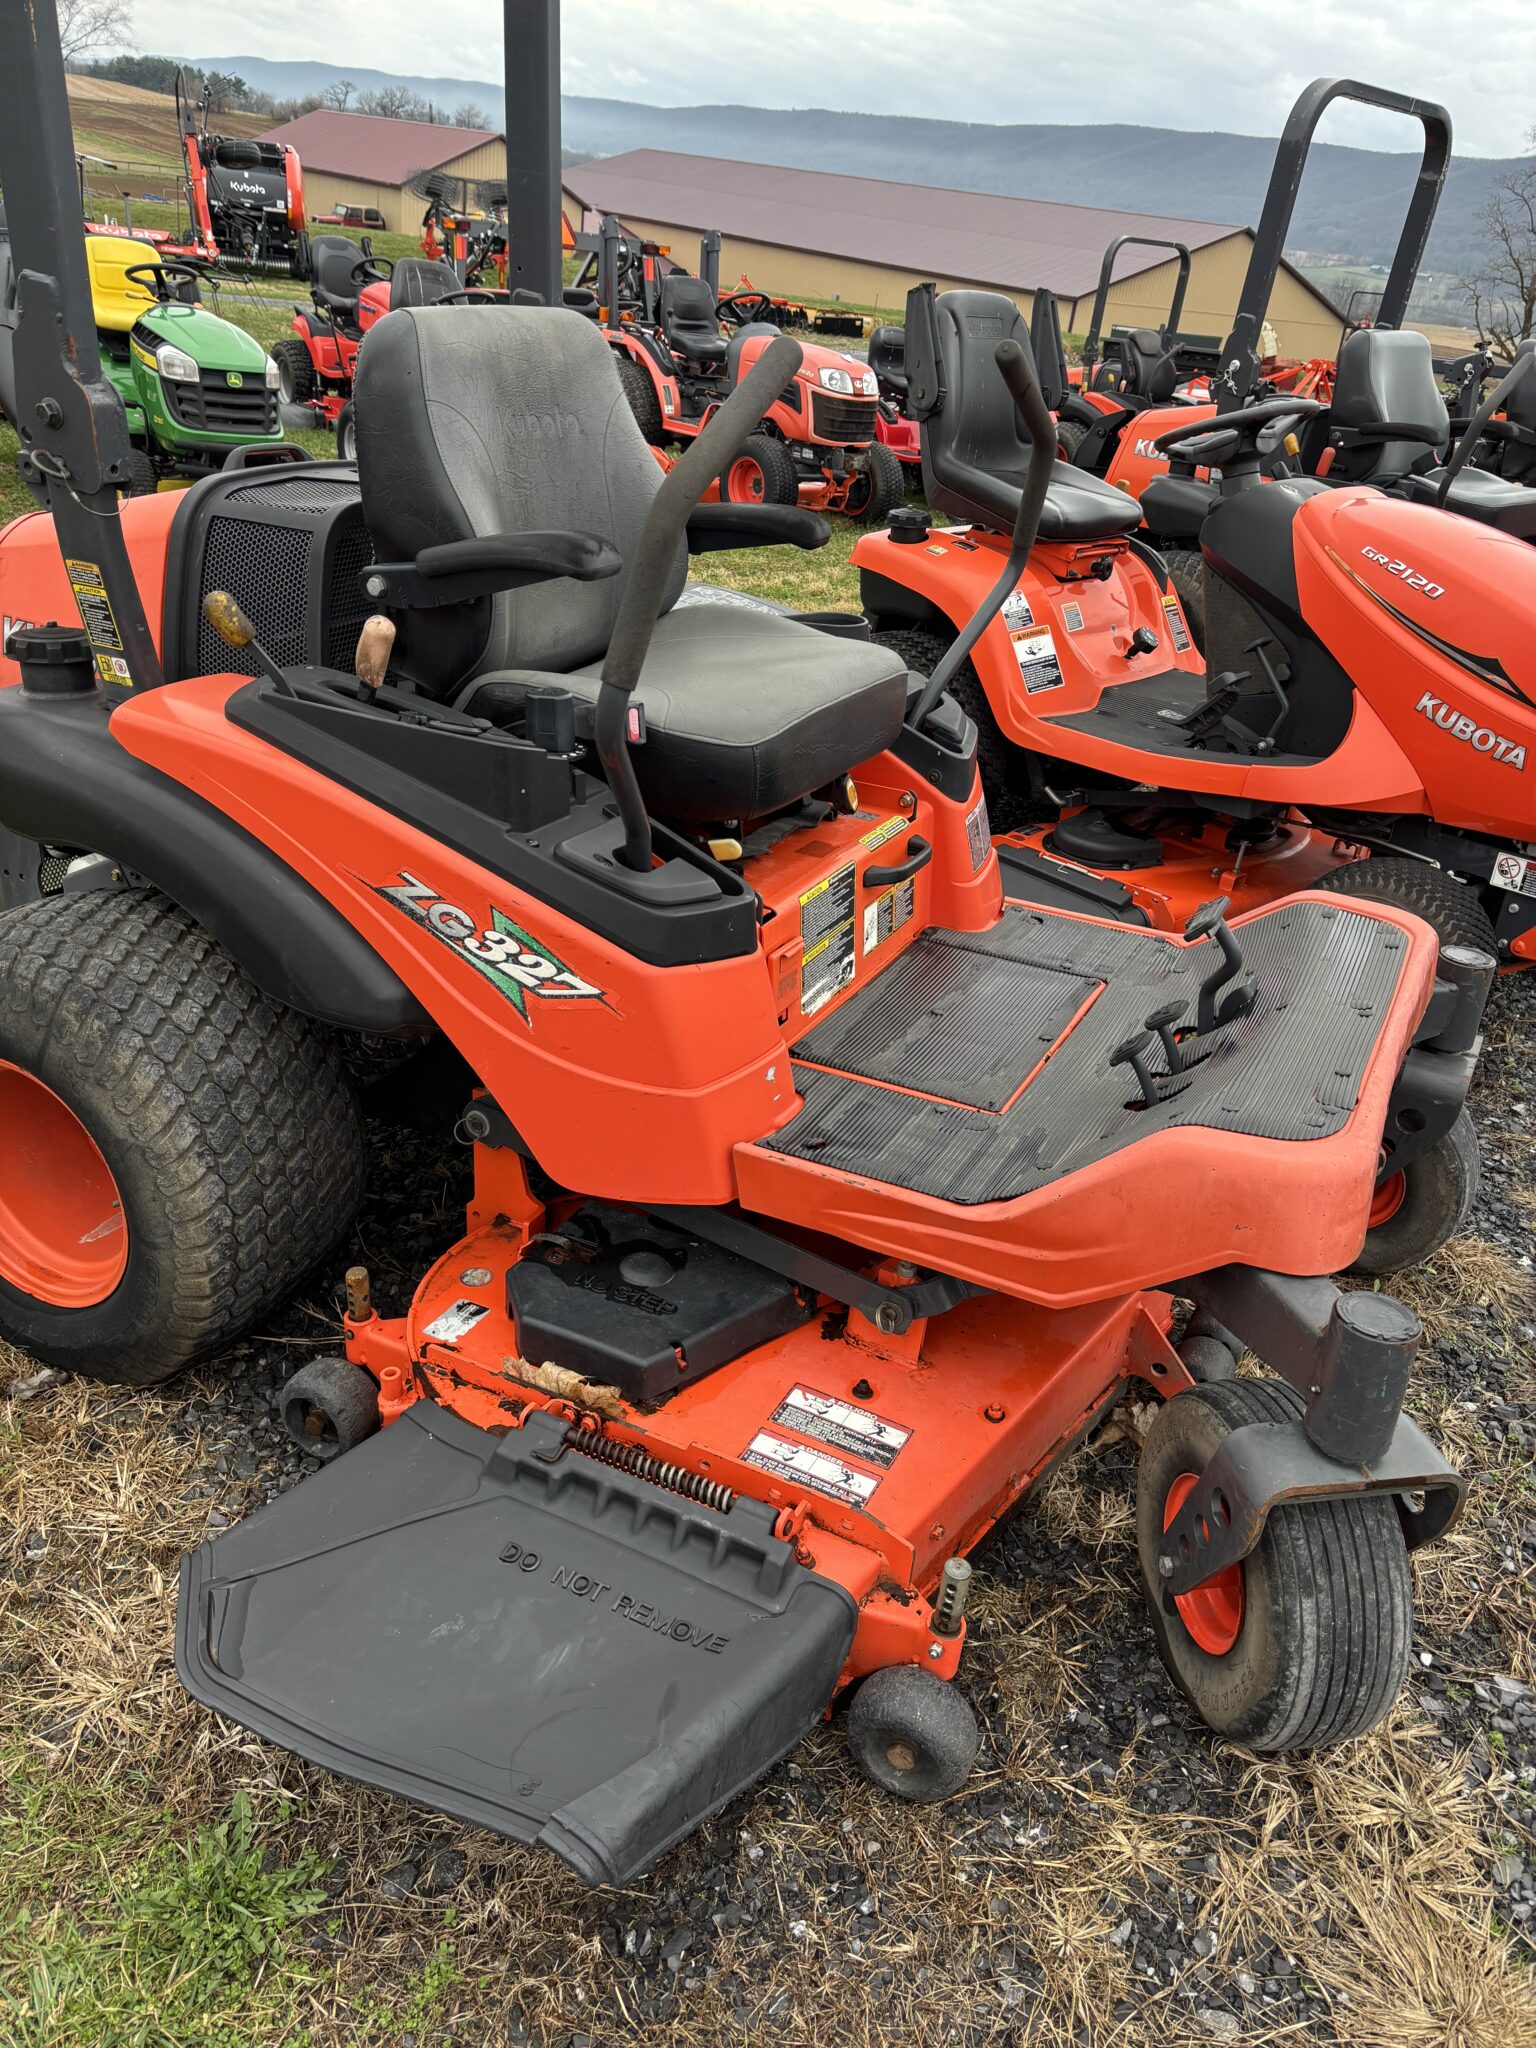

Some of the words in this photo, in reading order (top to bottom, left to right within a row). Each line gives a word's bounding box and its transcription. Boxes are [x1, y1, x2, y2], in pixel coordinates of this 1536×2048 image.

[230, 181, 266, 195] Kubota
[1361, 545, 1445, 600] GR2120
[1021, 628, 1046, 640] WARNING
[1415, 691, 1527, 771] KUBOTA
[574, 1272, 609, 1295] NO
[613, 1285, 679, 1316] STEP
[837, 1399, 878, 1421] PELIGRO
[804, 1446, 844, 1467] DANGER
[498, 1541, 543, 1572] DO
[550, 1564, 610, 1597] NOT
[611, 1591, 730, 1654] REMOVE
